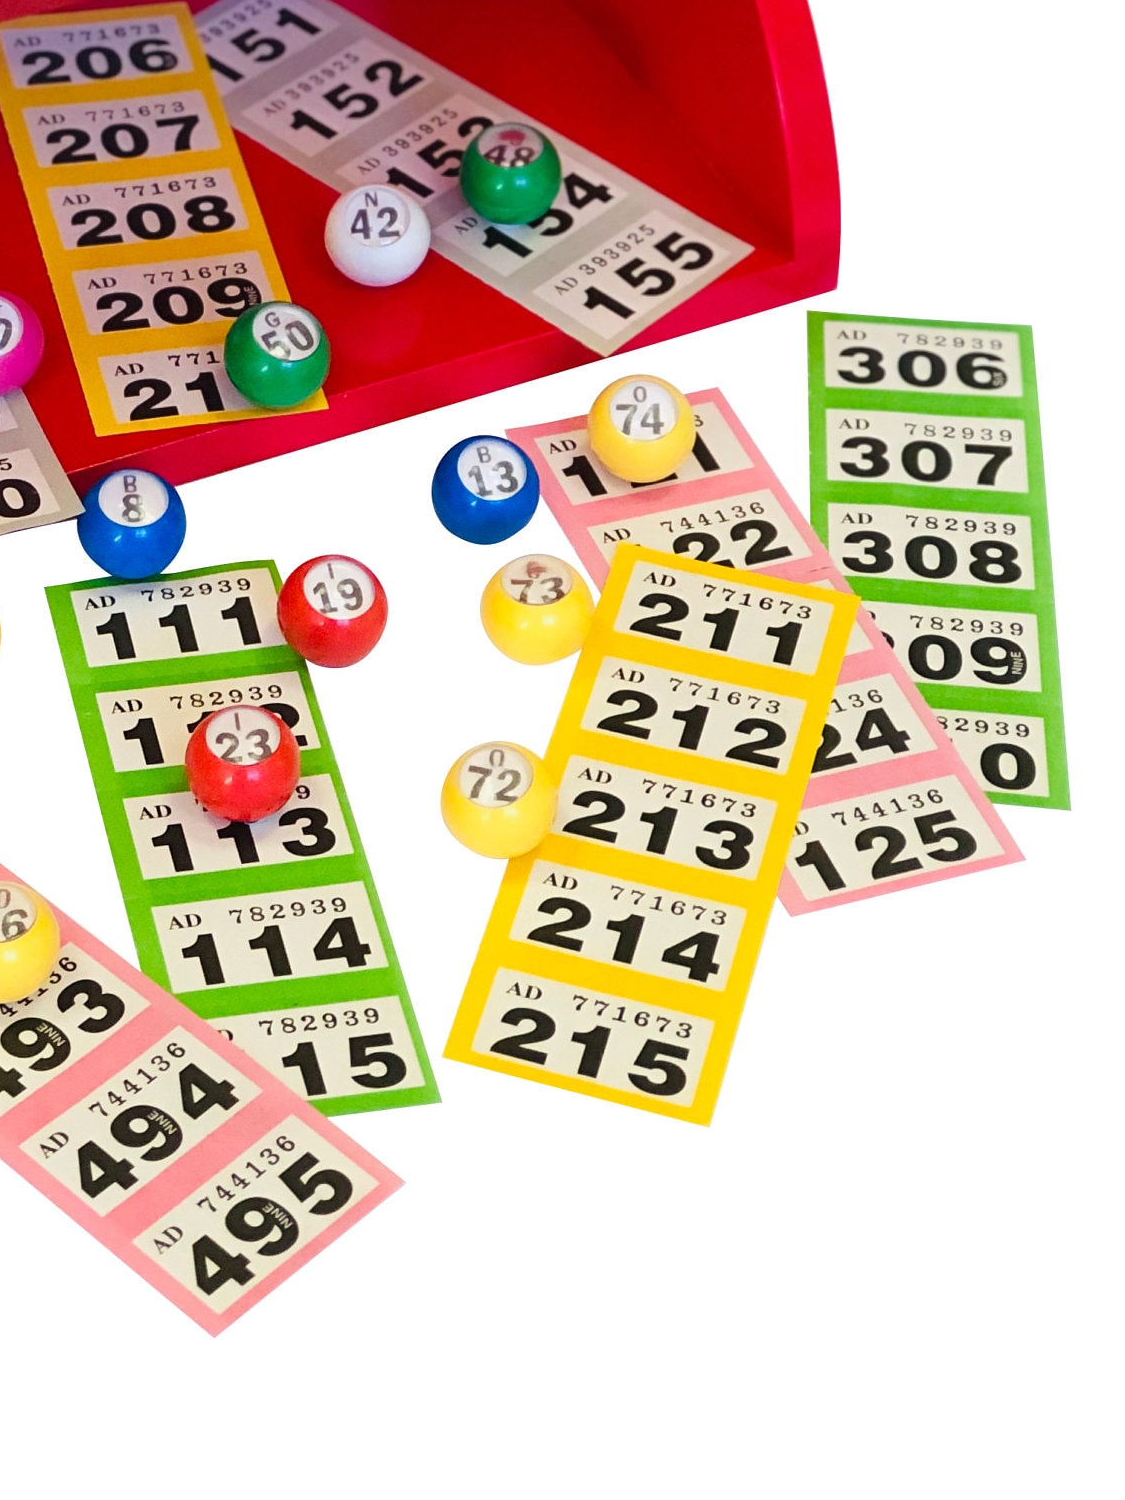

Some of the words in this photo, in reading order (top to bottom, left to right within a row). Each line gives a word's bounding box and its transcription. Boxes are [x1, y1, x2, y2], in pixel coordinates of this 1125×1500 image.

[63, 25, 159, 41] 771673
[207, 8, 321, 82] 151
[22, 38, 178, 85] 206
[39, 115, 65, 124] AD
[86, 103, 183, 123] 771673
[291, 60, 423, 139] 152
[46, 115, 199, 164] 207
[358, 158, 380, 176] AD
[382, 107, 458, 157] 393925
[115, 177, 216, 198] 771673
[365, 193, 378, 208] N
[71, 195, 235, 247] 208
[351, 207, 400, 240] 42
[578, 224, 654, 276] 393925
[144, 263, 247, 284] 771673
[584, 232, 713, 319] 155
[96, 277, 262, 332] 209
[265, 313, 282, 328] G
[260, 321, 314, 360] 50
[897, 333, 1002, 349] 782939
[838, 347, 1007, 390] 306
[615, 404, 665, 436] 74
[839, 419, 869, 429] AD
[905, 423, 1012, 441] 782939
[476, 447, 492, 464] B
[840, 437, 1012, 486] 307
[123, 475, 138, 493] B
[467, 460, 520, 498] 13
[121, 493, 145, 524] 8
[604, 529, 630, 543] AD
[660, 502, 764, 532] 744136
[906, 515, 1016, 535] 782939
[842, 531, 1021, 583] 308
[140, 578, 250, 602] 782939
[311, 578, 366, 615] 19
[510, 576, 565, 603] 73
[704, 584, 811, 619] 771673
[96, 597, 261, 660] 111
[630, 593, 802, 665] 211
[910, 615, 1023, 636] 782939
[170, 681, 282, 709] 782939
[670, 678, 780, 713] 771673
[214, 728, 273, 763] 23
[597, 690, 786, 768] 212
[467, 765, 523, 801] 72
[643, 779, 756, 817] 771673
[139, 805, 171, 819] AD
[831, 790, 943, 828] 744136
[152, 808, 336, 872] 113
[562, 791, 753, 870] 213
[795, 810, 977, 891] 125
[229, 898, 346, 923] 782939
[543, 873, 577, 890] AD
[611, 885, 726, 925] 771673
[182, 917, 371, 985] 114
[527, 897, 719, 982] 214
[259, 1008, 379, 1035] 782939
[573, 995, 692, 1038] 771673
[490, 1008, 689, 1096] 215
[89, 1043, 185, 1116] 744136
[78, 1063, 239, 1198] 494
[197, 1136, 295, 1212] 744136
[192, 1152, 353, 1295] 495
